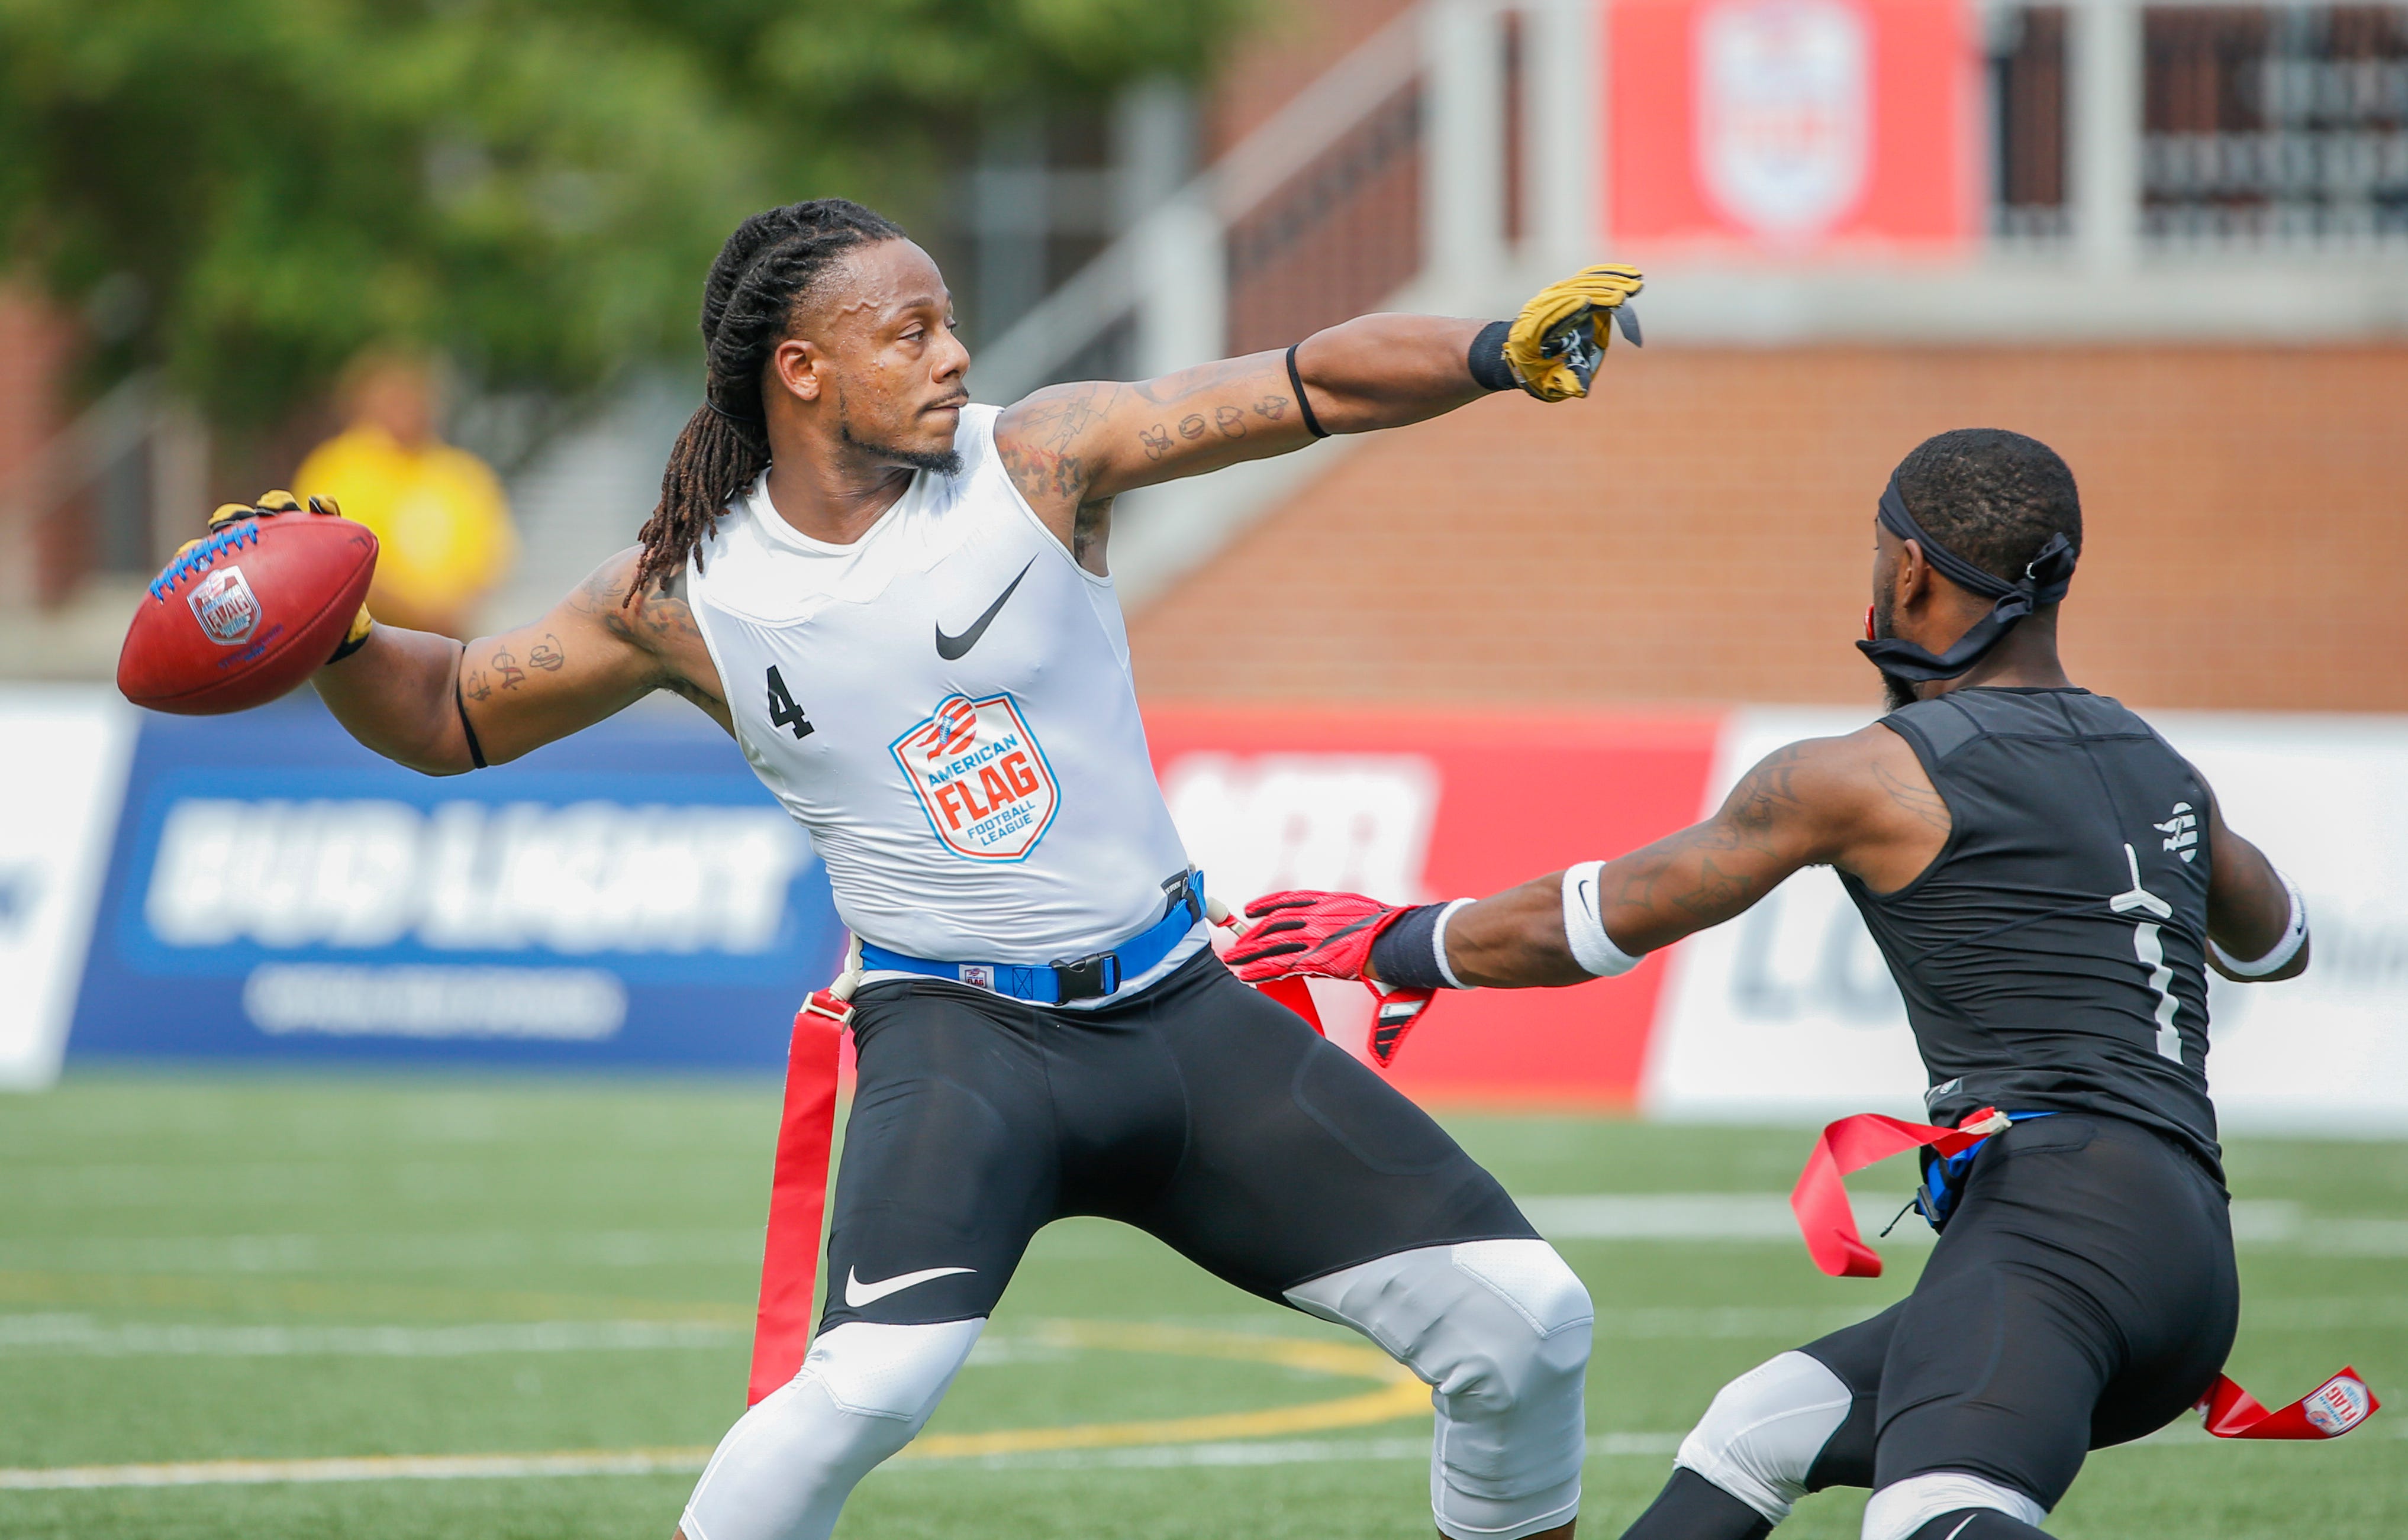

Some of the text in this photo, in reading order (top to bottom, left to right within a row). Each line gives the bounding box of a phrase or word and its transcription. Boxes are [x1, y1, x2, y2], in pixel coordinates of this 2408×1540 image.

[767, 664, 815, 740] 4
[928, 733, 1018, 787] AMERICAN
[934, 750, 1039, 831] FLAG
[966, 800, 1036, 840] FOOTBALL
[980, 813, 1033, 847] LEAGUE
[2326, 1386, 2358, 1422] FLAG
